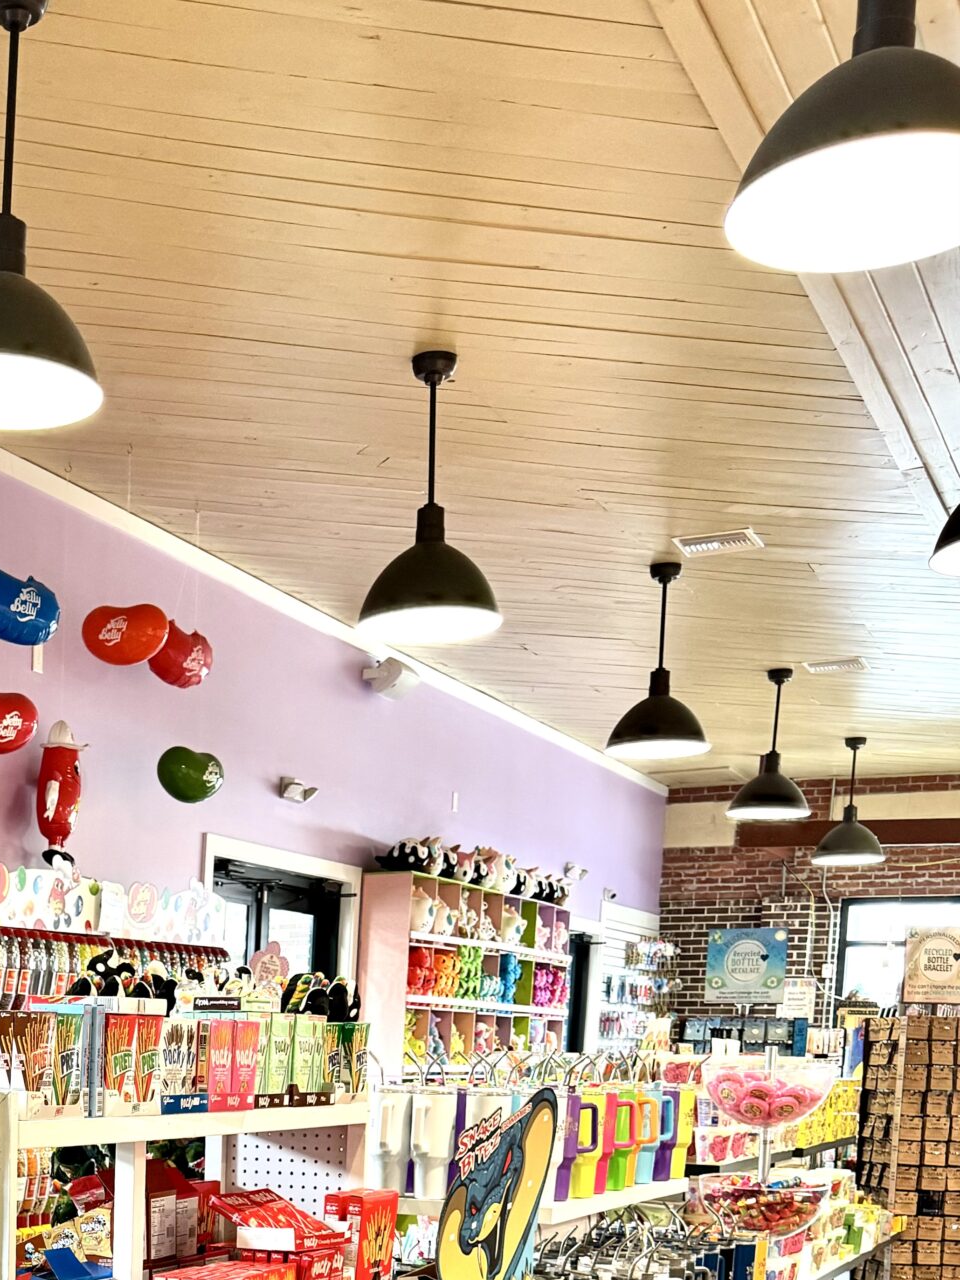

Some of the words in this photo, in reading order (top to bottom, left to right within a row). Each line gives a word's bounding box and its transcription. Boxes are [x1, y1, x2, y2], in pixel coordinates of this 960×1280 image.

[10, 599, 38, 617] Belly
[923, 964, 953, 972] BRACELET
[455, 1109, 502, 1159] SNAKE
